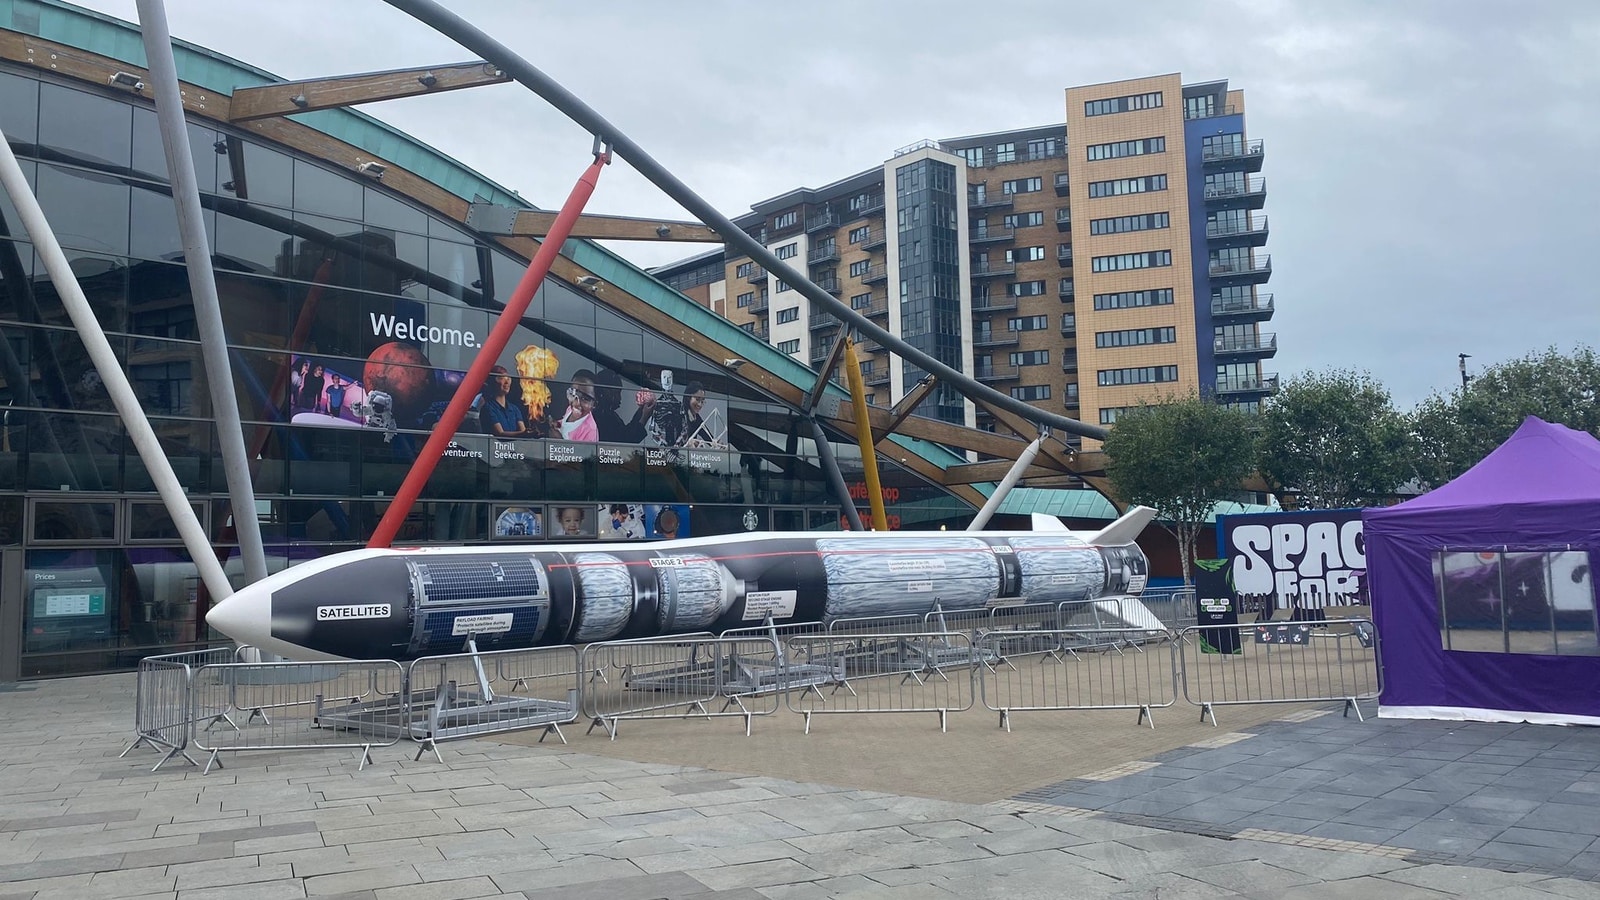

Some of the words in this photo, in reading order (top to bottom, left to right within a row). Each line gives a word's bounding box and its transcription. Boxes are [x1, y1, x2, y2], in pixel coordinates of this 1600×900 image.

[370, 312, 481, 348] Welcome.
[494, 441, 515, 451] Thrill
[549, 445, 575, 454] Excited
[442, 448, 483, 458] venturers
[494, 450, 525, 460] Seekers
[599, 447, 621, 457] Puzzle
[549, 453, 583, 463] Explorers
[599, 455, 624, 465] Solvers
[646, 457, 667, 467] Lovers
[690, 453, 721, 462] Marvellous
[690, 460, 712, 469] Makers
[847, 481, 868, 499] afé
[651, 559, 677, 567] STAGE
[1232, 520, 1366, 597] SPAC
[320, 605, 389, 618] SATELLITES
